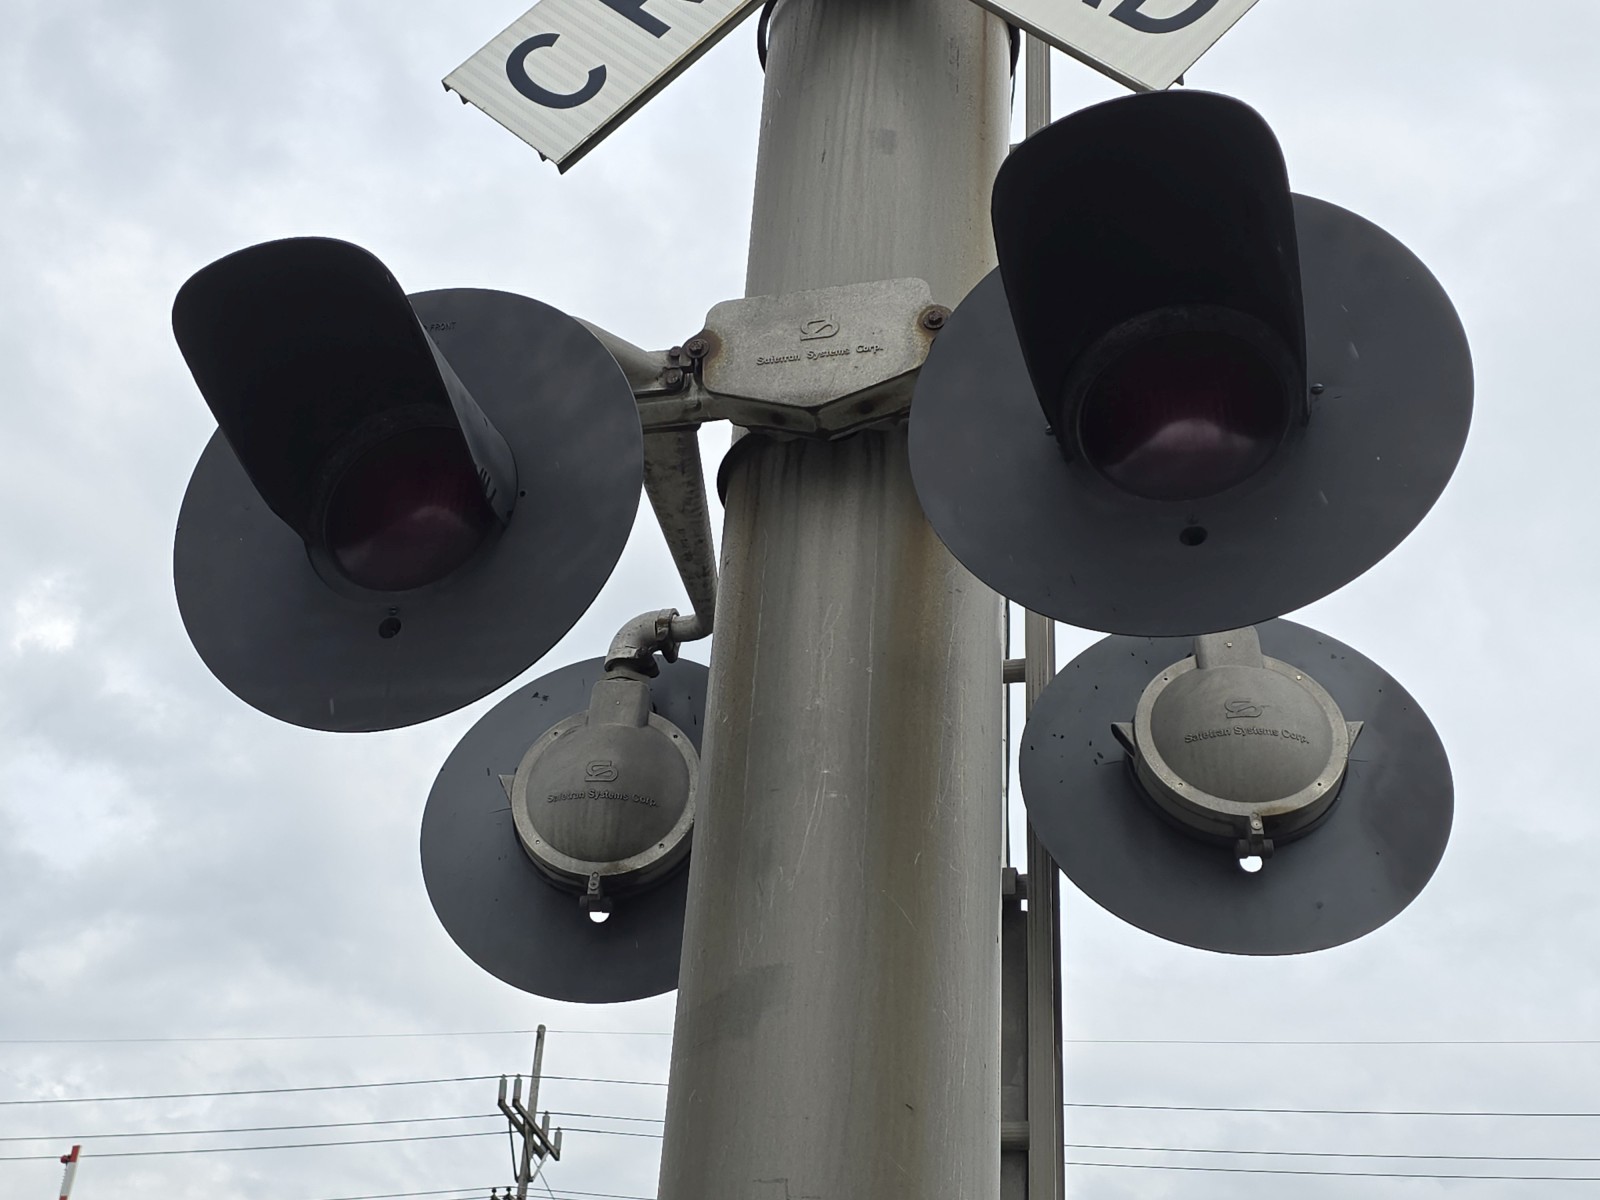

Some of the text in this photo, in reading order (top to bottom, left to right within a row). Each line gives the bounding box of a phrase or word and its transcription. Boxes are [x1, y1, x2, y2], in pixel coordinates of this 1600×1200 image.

[806, 347, 851, 360] Systems
[856, 344, 884, 355] Corp.
[1184, 725, 1310, 744] Safetran Systems Corp.
[546, 788, 661, 808] Safetran Systems Corp.
